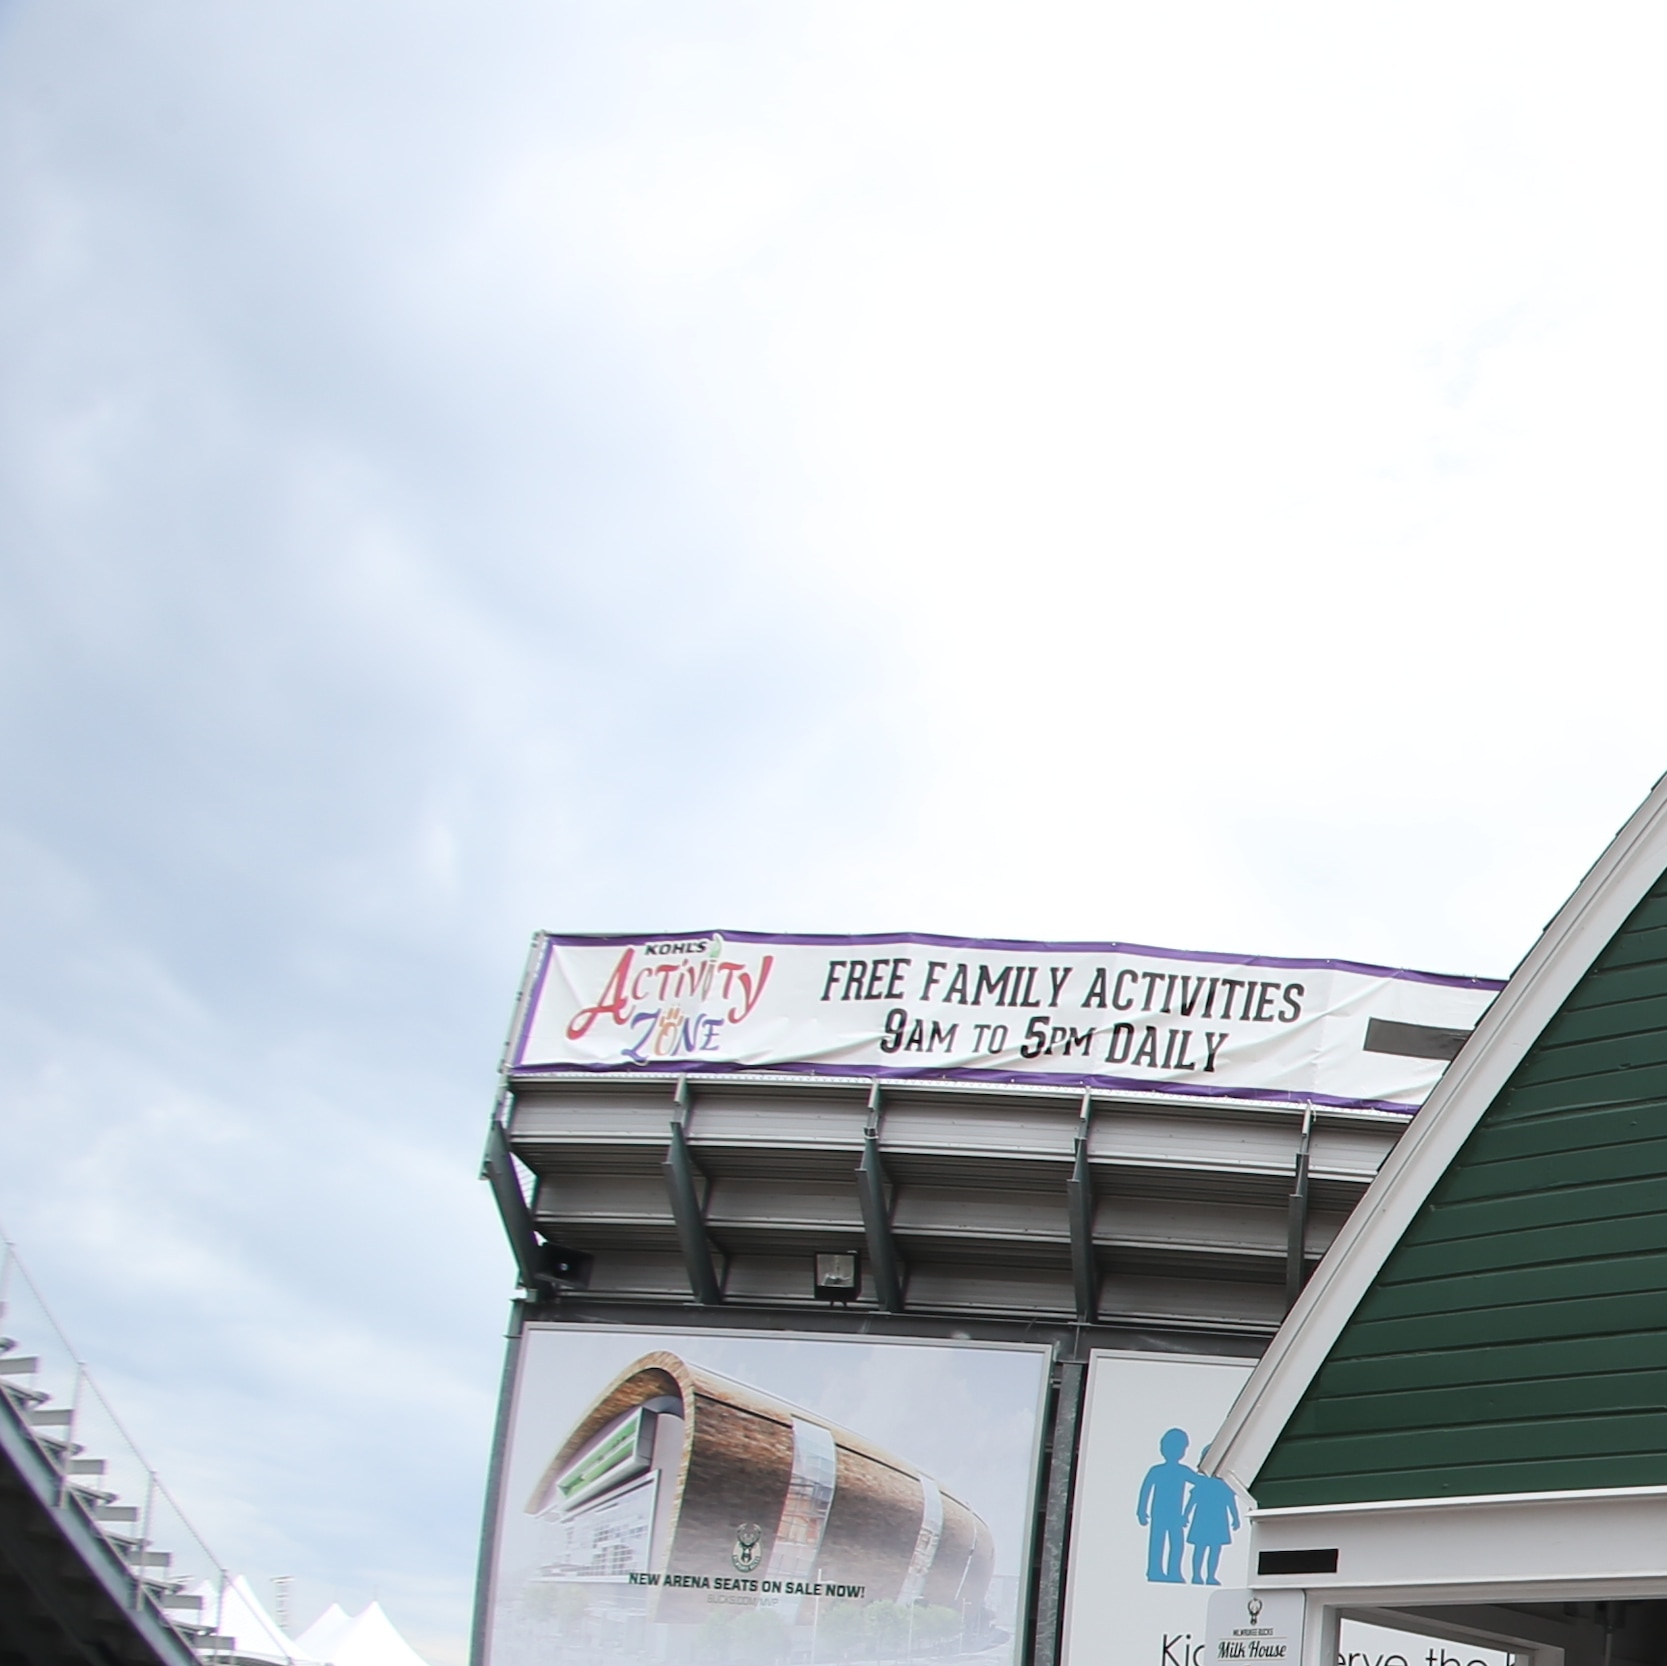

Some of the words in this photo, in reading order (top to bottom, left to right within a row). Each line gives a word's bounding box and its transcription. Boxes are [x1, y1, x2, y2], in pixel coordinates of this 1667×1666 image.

[644, 939, 708, 957] KOHL'S
[820, 957, 912, 1002] FREE
[919, 960, 1074, 1008] FAMILY
[1082, 967, 1306, 1023] ACTIVITIES
[879, 1007, 959, 1054] 9AM
[972, 1023, 1009, 1055] TO
[1020, 1015, 1096, 1060] 5PM
[1104, 1022, 1231, 1073] DAILY
[629, 1573, 662, 1586] NEW
[663, 1574, 710, 1589] ARENA
[713, 1577, 758, 1592] SEATS
[761, 1580, 782, 1593] ON
[785, 1581, 822, 1596] SALE
[825, 1583, 866, 1598] NOW!
[1217, 1641, 1246, 1659] Milk
[1248, 1640, 1287, 1658] House
